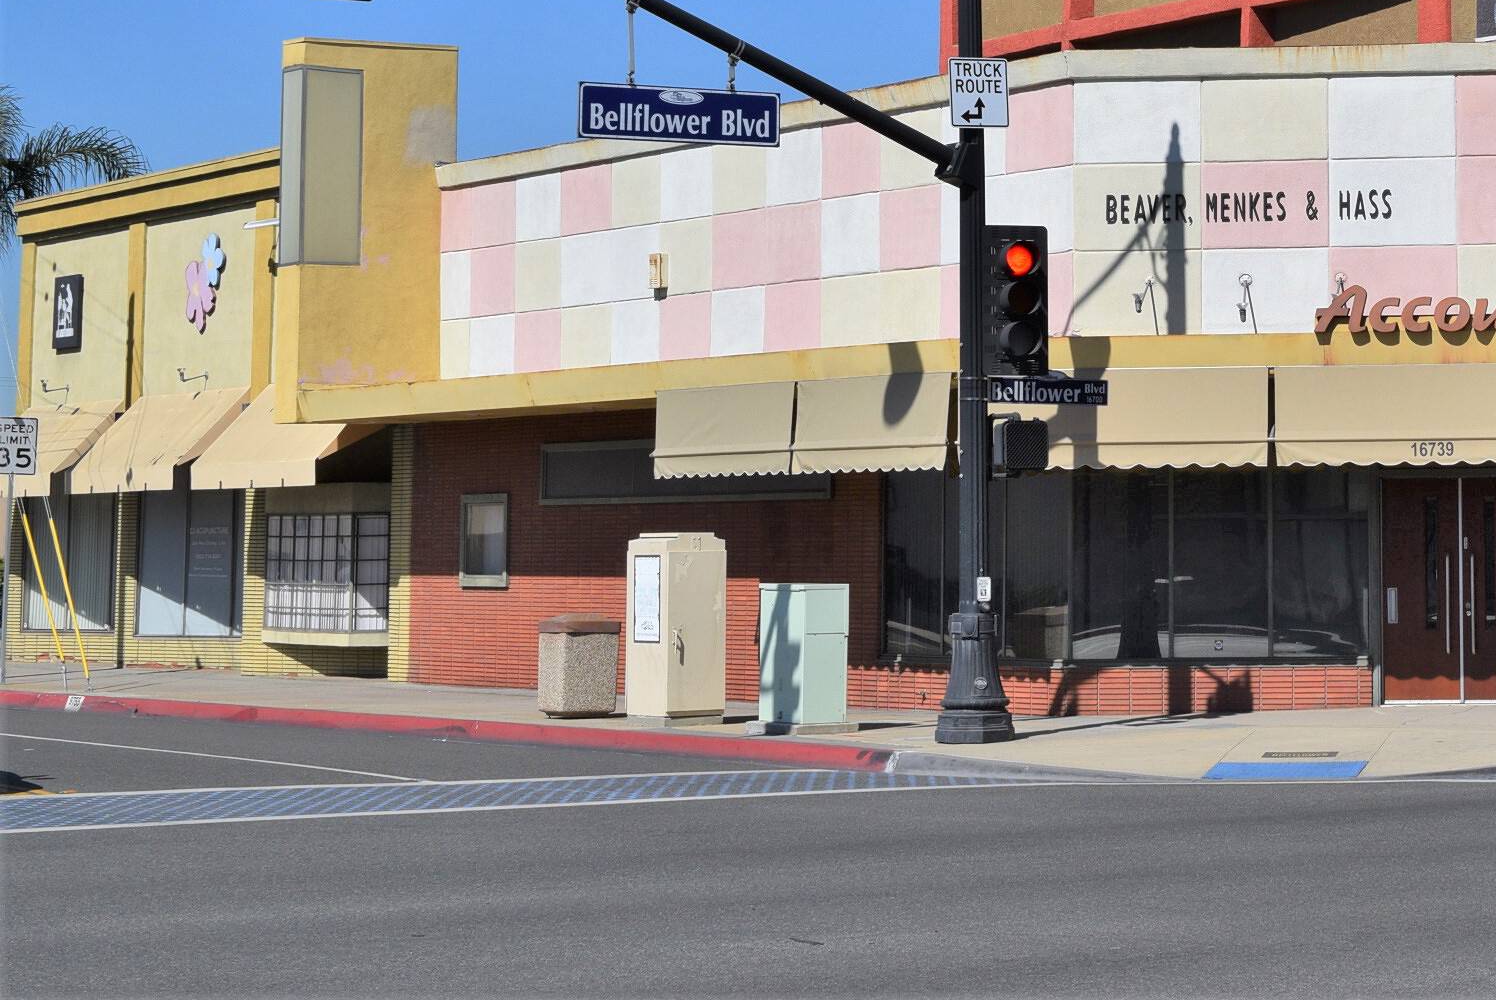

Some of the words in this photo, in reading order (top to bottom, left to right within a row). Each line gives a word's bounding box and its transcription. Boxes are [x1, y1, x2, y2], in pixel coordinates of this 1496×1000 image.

[954, 63, 1002, 77] TRUCK
[956, 79, 1002, 94] ROUTE
[589, 102, 711, 135] Bellflower
[721, 109, 770, 138] Blvd
[1105, 194, 1193, 226] BEAVER,
[1205, 191, 1287, 223] MENKES
[1305, 190, 1319, 221] &
[1339, 188, 1393, 220] HASS
[992, 381, 1081, 403] Bellflower
[1084, 383, 1105, 394] Blvd
[1411, 441, 1454, 457] 16739
